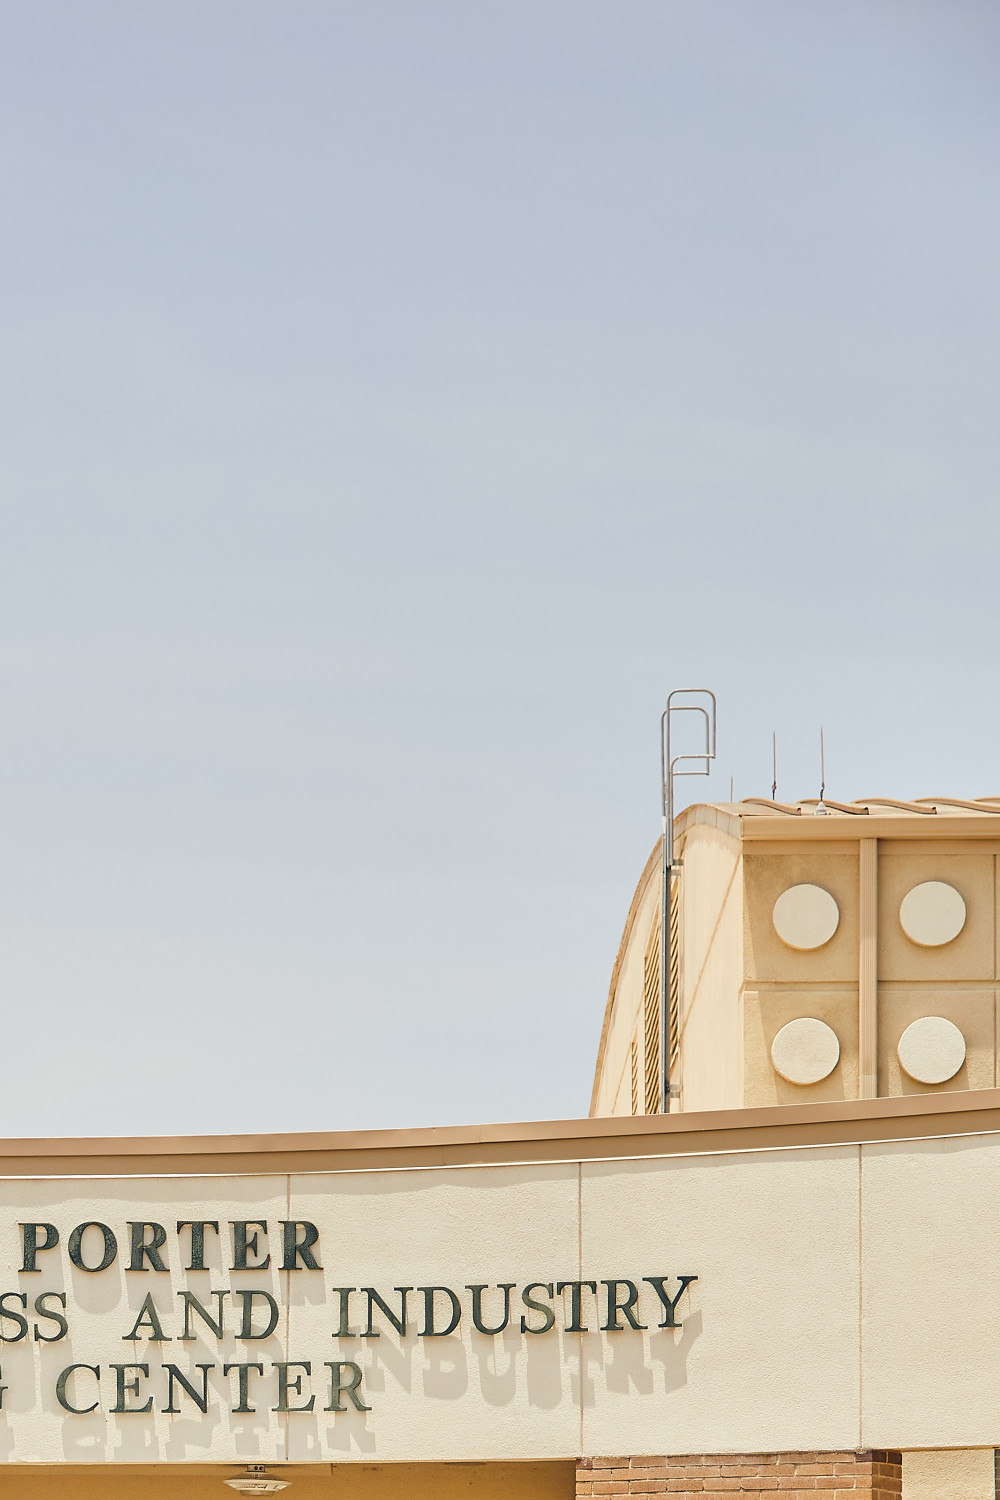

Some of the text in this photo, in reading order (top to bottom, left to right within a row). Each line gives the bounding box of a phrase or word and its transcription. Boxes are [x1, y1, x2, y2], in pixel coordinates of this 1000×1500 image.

[17, 1219, 324, 1273] PORTER
[121, 1289, 280, 1341] AND
[331, 1275, 699, 1339] INDUSTRY
[55, 1360, 372, 1415] CENTER
